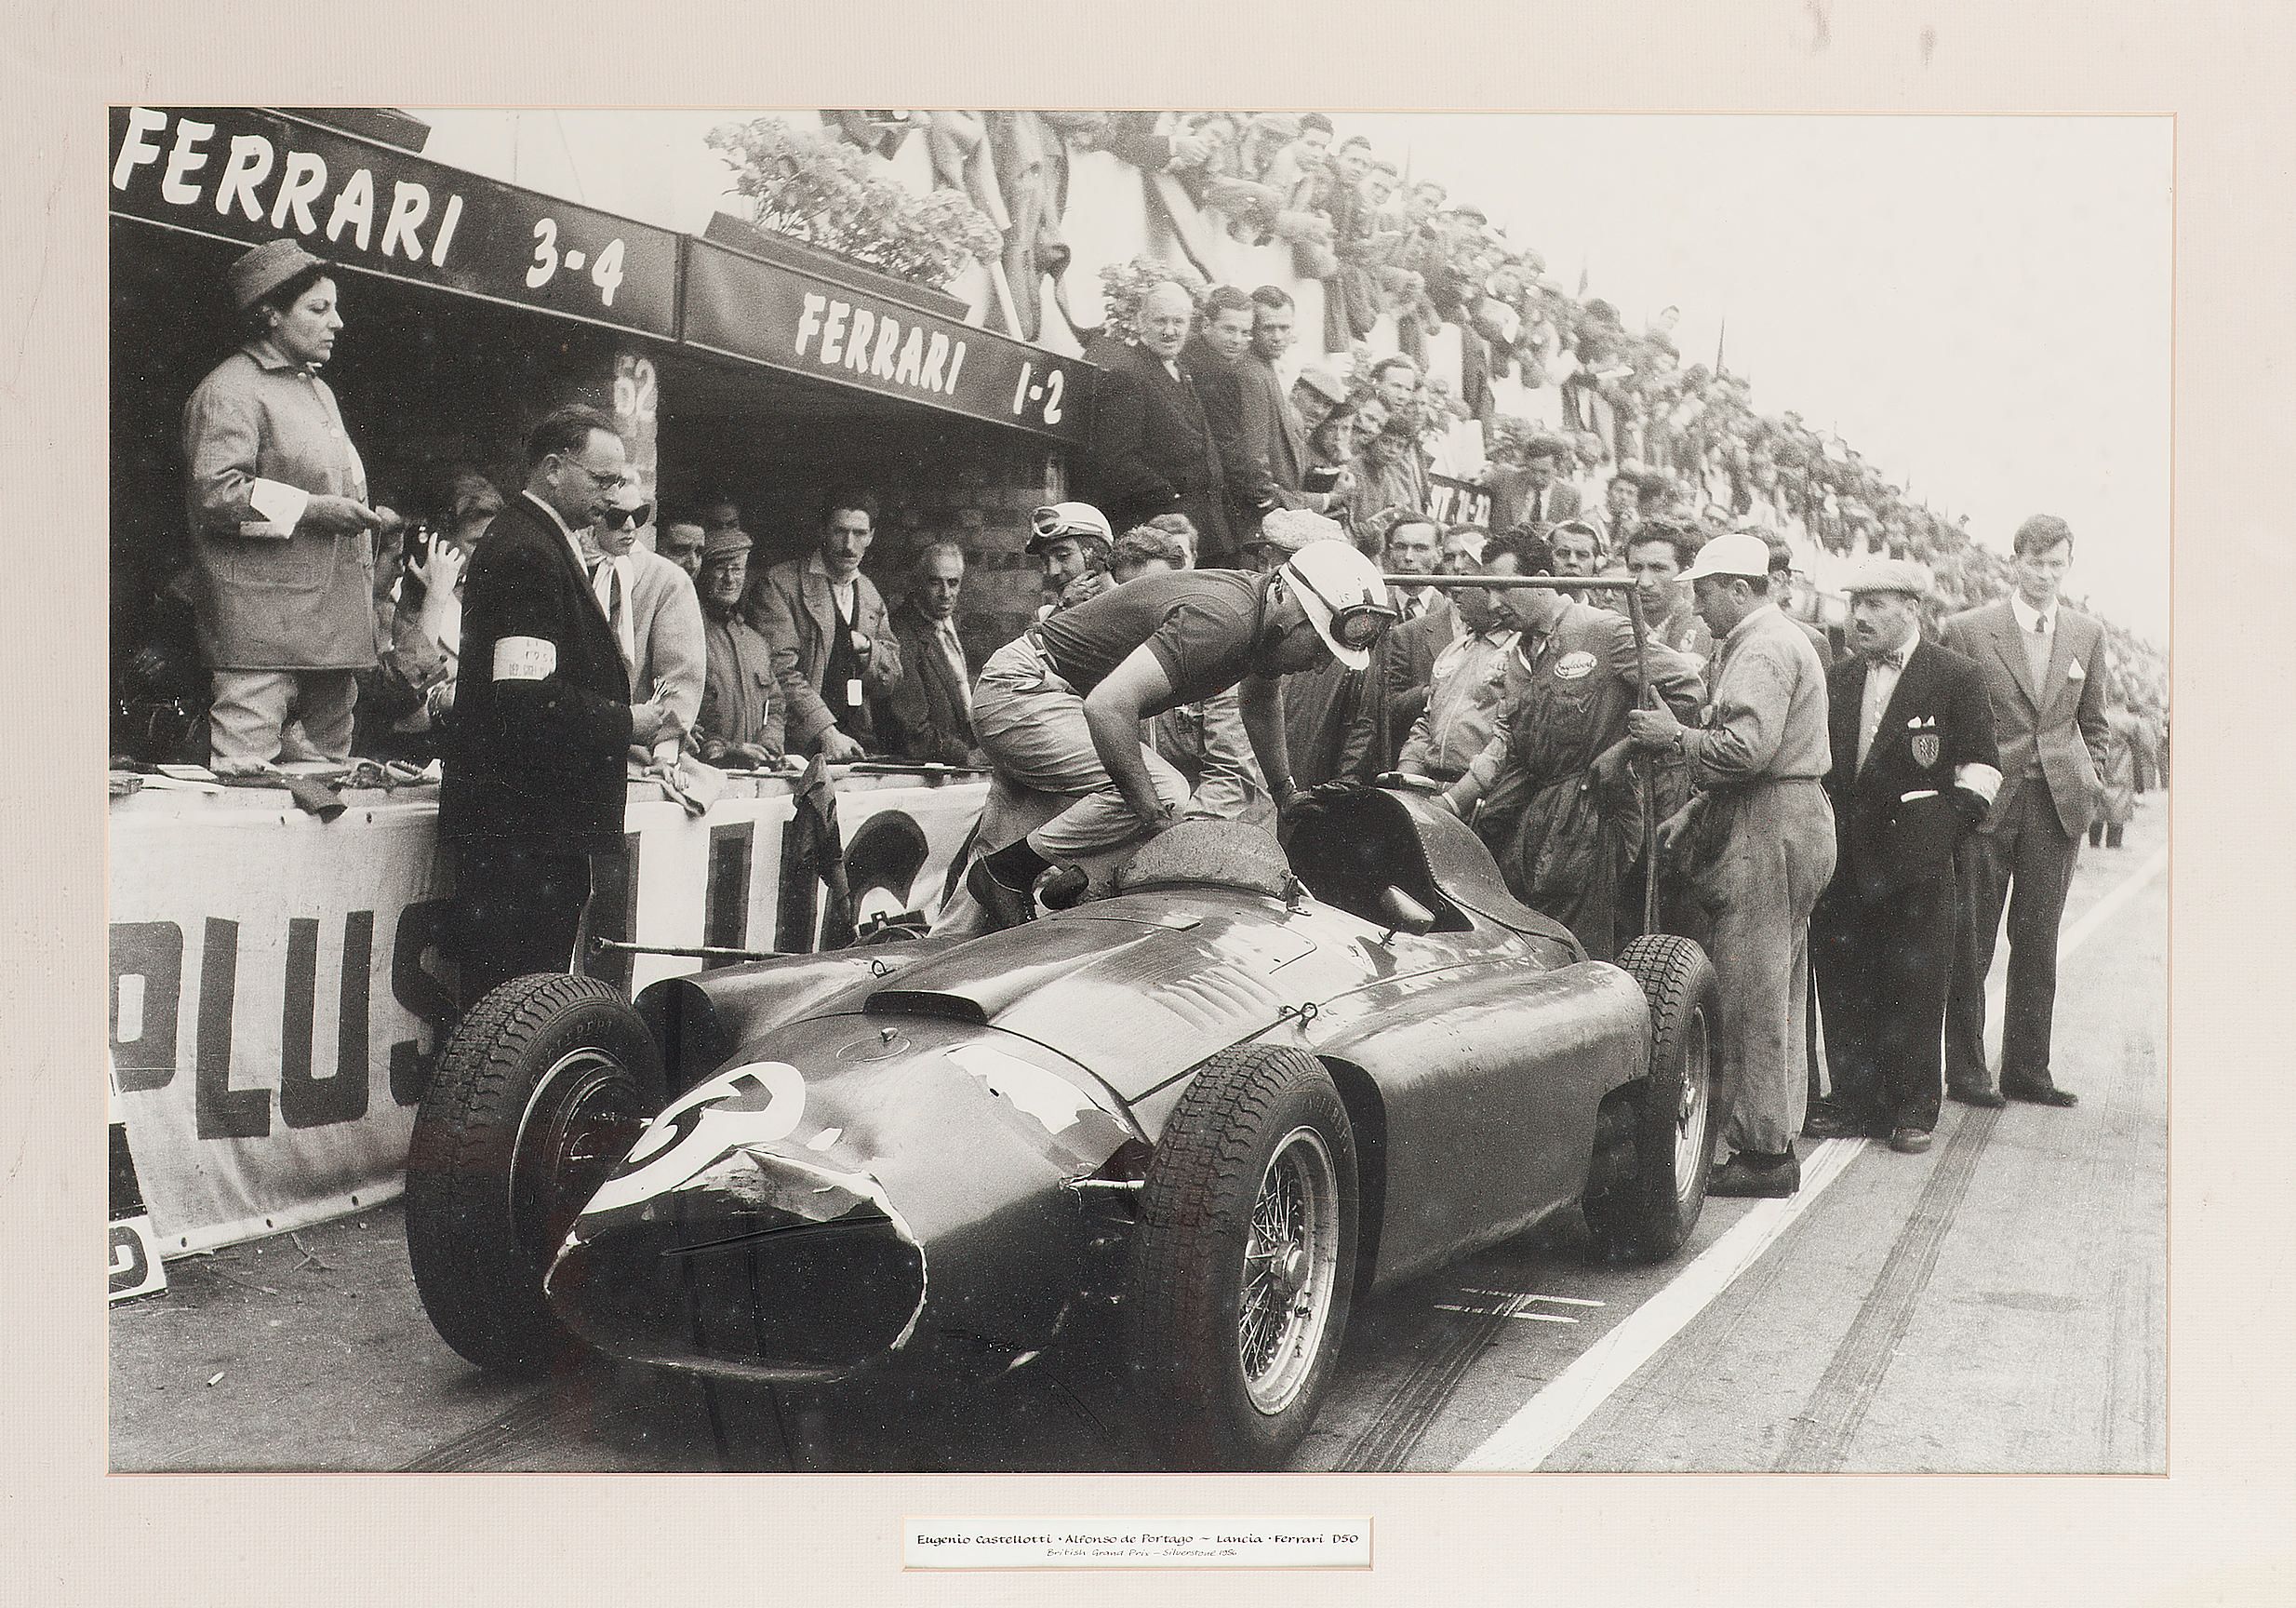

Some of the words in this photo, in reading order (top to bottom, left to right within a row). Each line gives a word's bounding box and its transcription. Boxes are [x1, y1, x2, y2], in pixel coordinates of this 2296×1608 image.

[113, 107, 463, 267] FERRARI
[526, 217, 624, 307] 3-4
[794, 291, 967, 395] FERRARI
[916, 1534, 971, 1547] Eugenio
[975, 1534, 1053, 1545] Castellotti
[1120, 1534, 1137, 1544] de
[1141, 1533, 1194, 1547] Portago
[1216, 1533, 1264, 1544] Lancia
[1331, 1534, 1359, 1544] D50
[1047, 1548, 1087, 1557] British
[1091, 1548, 1124, 1557] Grand
[1128, 1548, 1150, 1557] Prix
[1162, 1547, 1217, 1557] Silverstone
